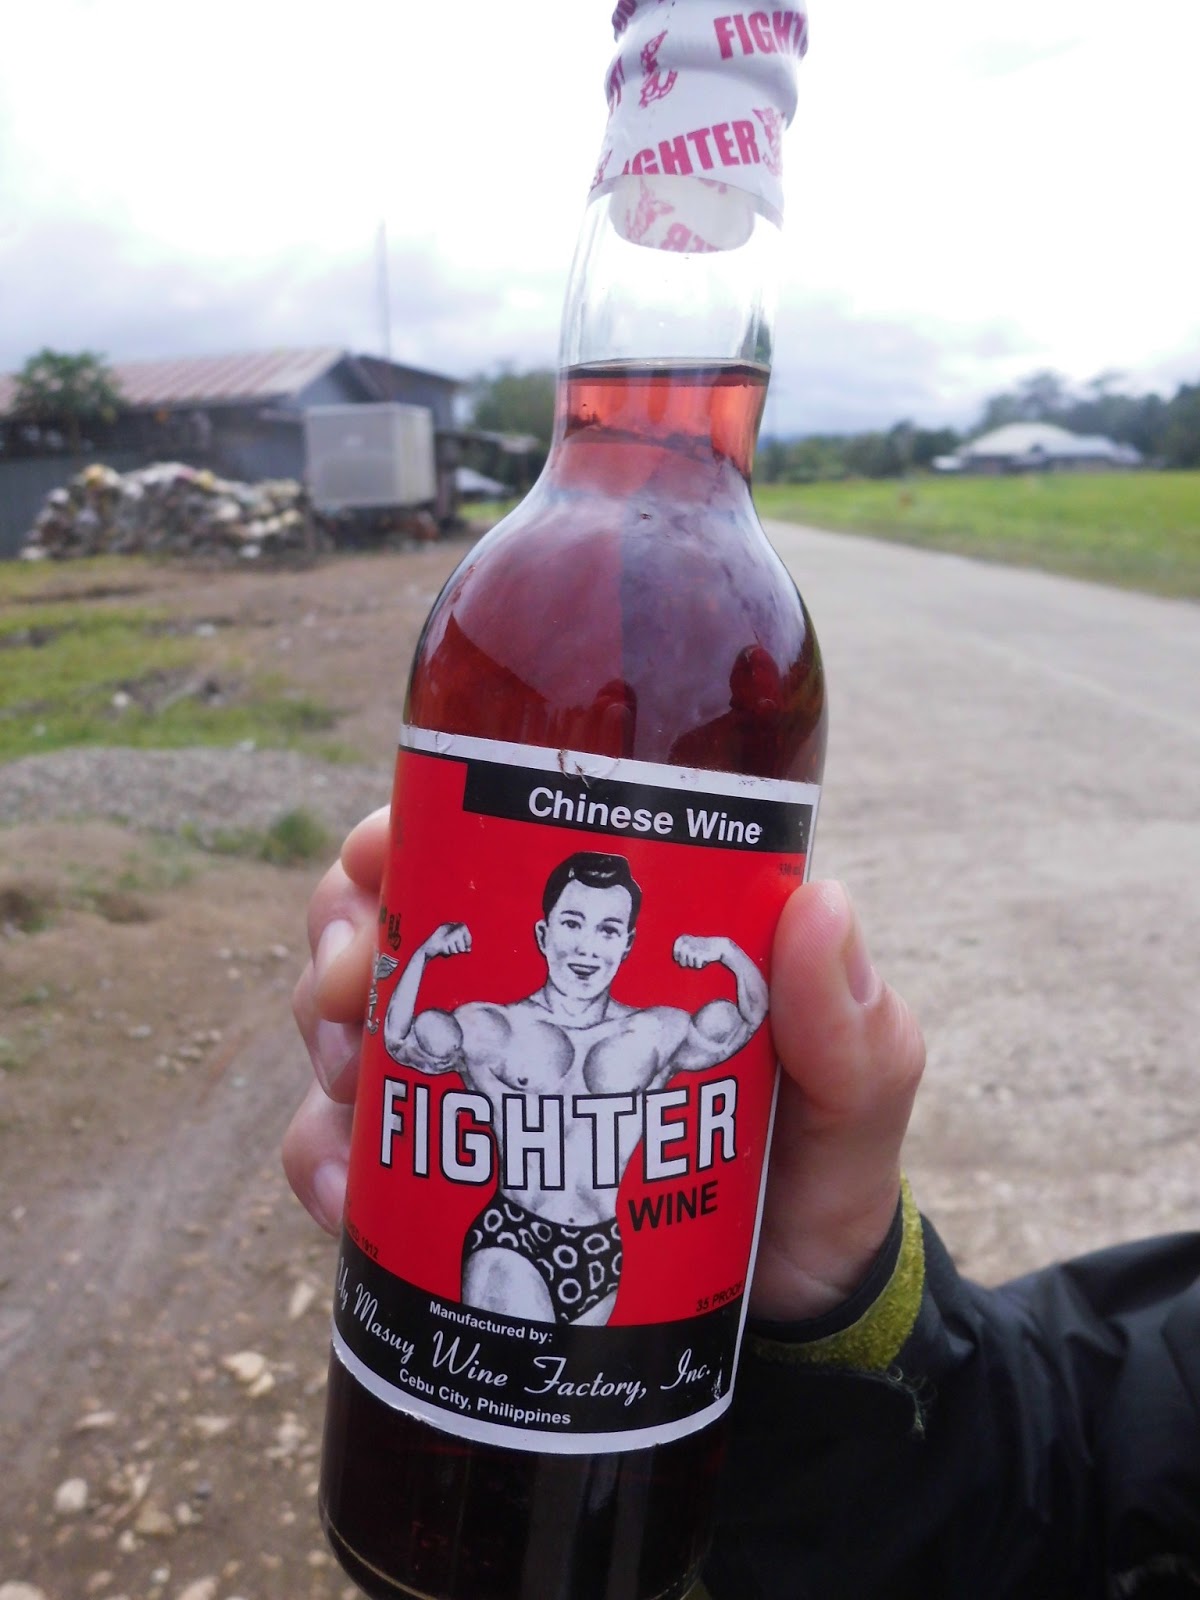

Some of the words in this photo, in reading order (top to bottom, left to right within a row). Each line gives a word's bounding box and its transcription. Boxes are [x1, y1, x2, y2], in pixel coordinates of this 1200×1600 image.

[713, 10, 808, 60] FIGHT
[622, 119, 760, 176] GHTER
[528, 786, 674, 835] Chinese
[686, 807, 763, 845] Wine
[380, 1074, 738, 1192] FIGHTER
[627, 1180, 719, 1232] WINE
[429, 1300, 526, 1339] Manufactured
[529, 1328, 554, 1345] by:
[695, 1297, 710, 1312] 35
[353, 1283, 416, 1365] Masuy
[432, 1330, 509, 1387] Wine
[524, 1356, 648, 1407] Factory,
[660, 1348, 711, 1390] Inc.
[399, 1368, 435, 1396] Cebu
[438, 1386, 472, 1411] City,
[476, 1397, 572, 1425] Philippines
